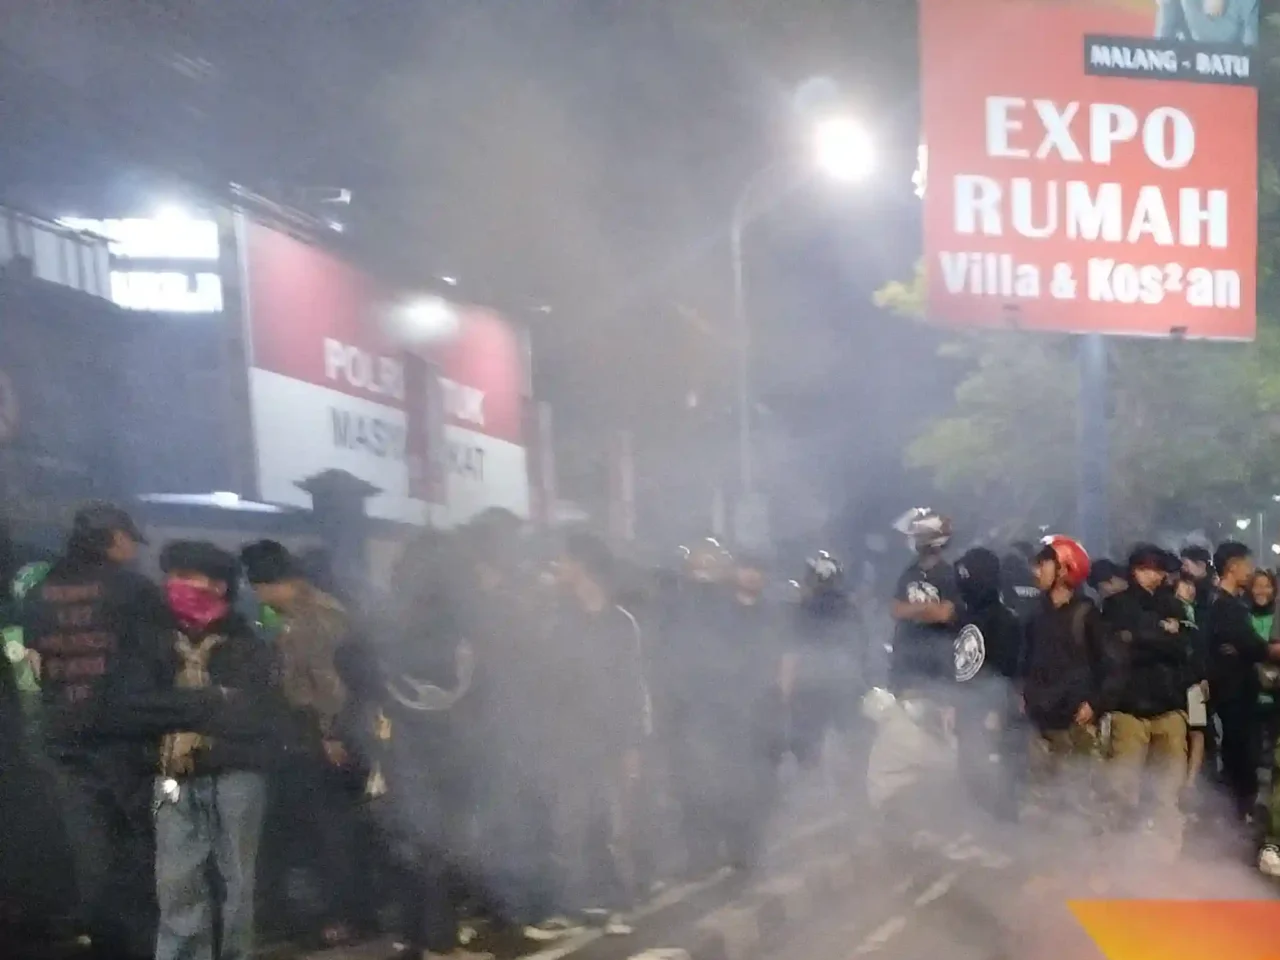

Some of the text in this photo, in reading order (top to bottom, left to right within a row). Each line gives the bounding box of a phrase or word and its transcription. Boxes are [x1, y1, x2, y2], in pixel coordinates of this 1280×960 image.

[1090, 45, 1178, 72] MALANG
[1195, 52, 1250, 78] BATU
[985, 96, 1196, 169] EXPO
[954, 173, 1228, 248] RUMAH
[940, 250, 1040, 298] Villa
[1050, 261, 1077, 299] &
